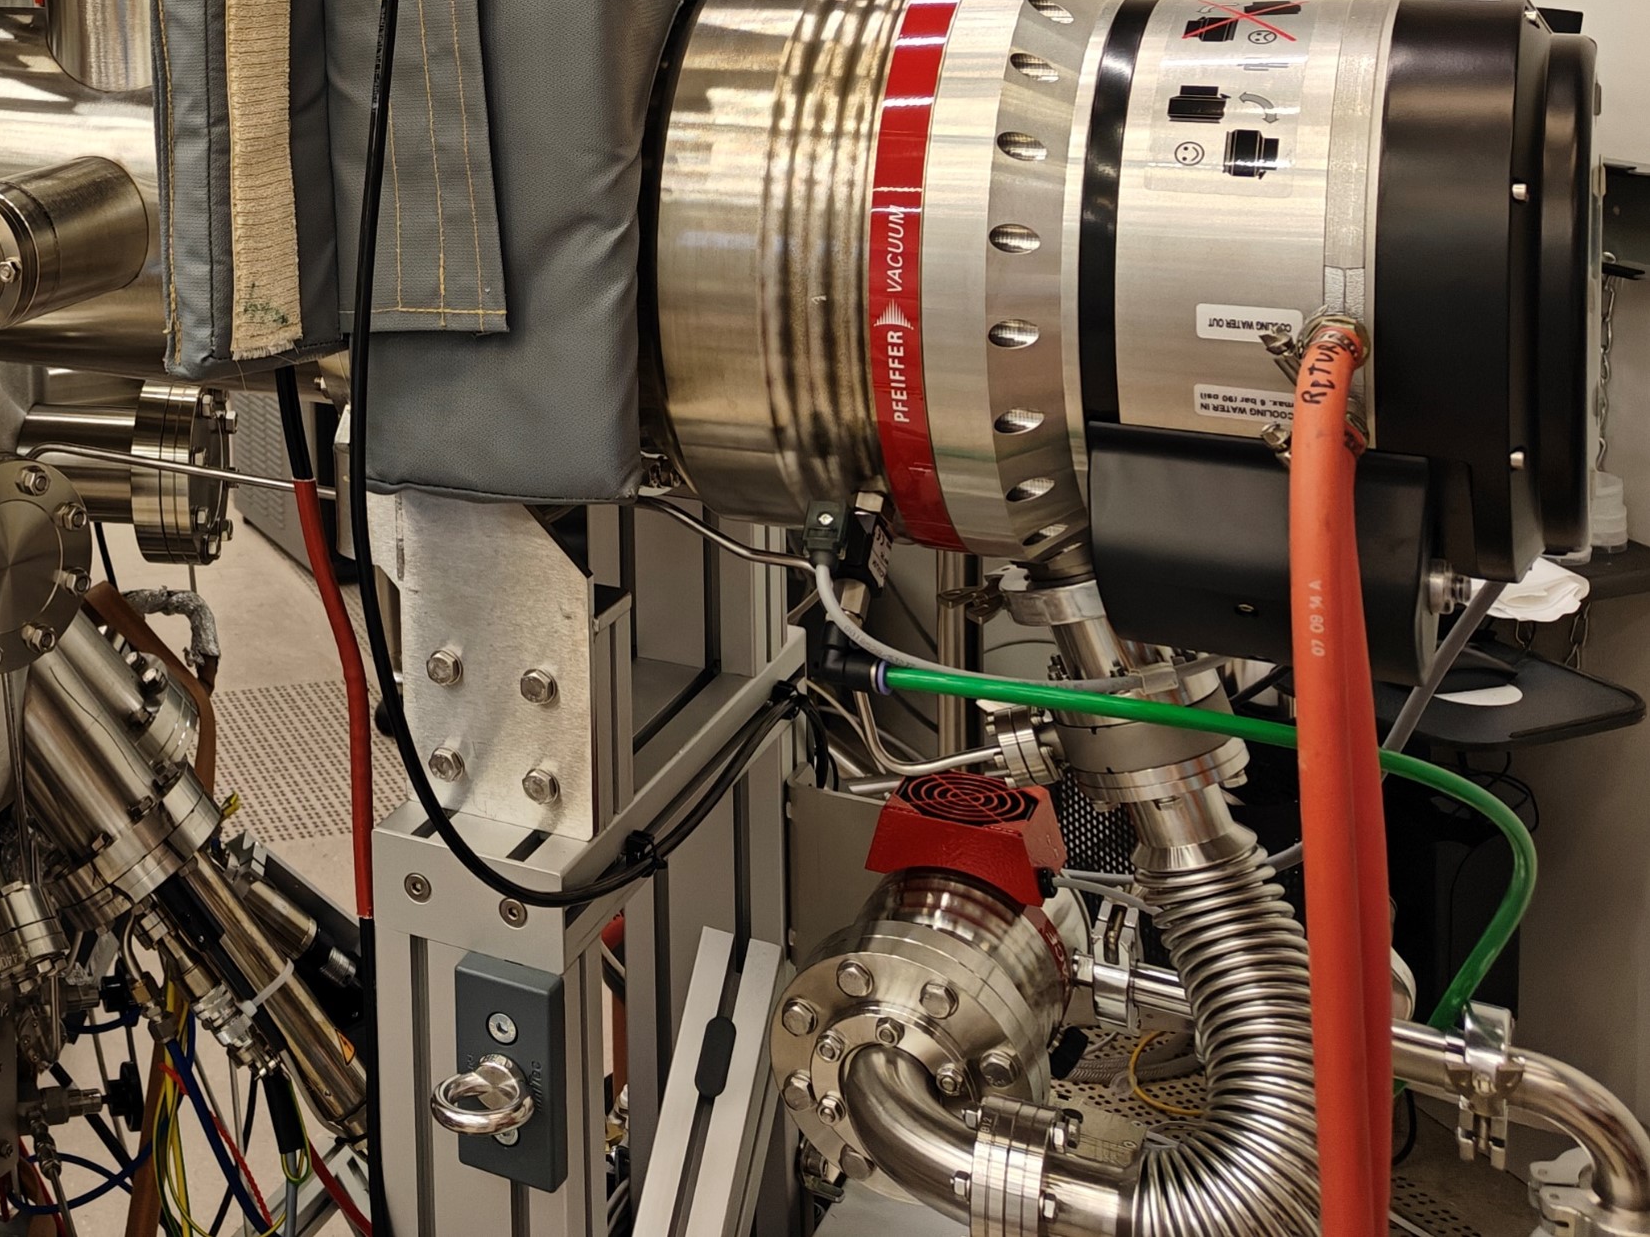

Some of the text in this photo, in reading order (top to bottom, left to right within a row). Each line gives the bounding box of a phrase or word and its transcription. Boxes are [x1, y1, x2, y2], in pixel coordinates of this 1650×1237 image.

[886, 204, 910, 423] PFEIFFER VACUUM
[1208, 317, 1224, 328] OUT
[1225, 318, 1254, 330] WATER
[1241, 396, 1257, 406] bar
[1259, 398, 1266, 407] 6
[1269, 399, 1294, 408] max.
[1200, 402, 1211, 411] IN
[1211, 404, 1247, 415] WATER
